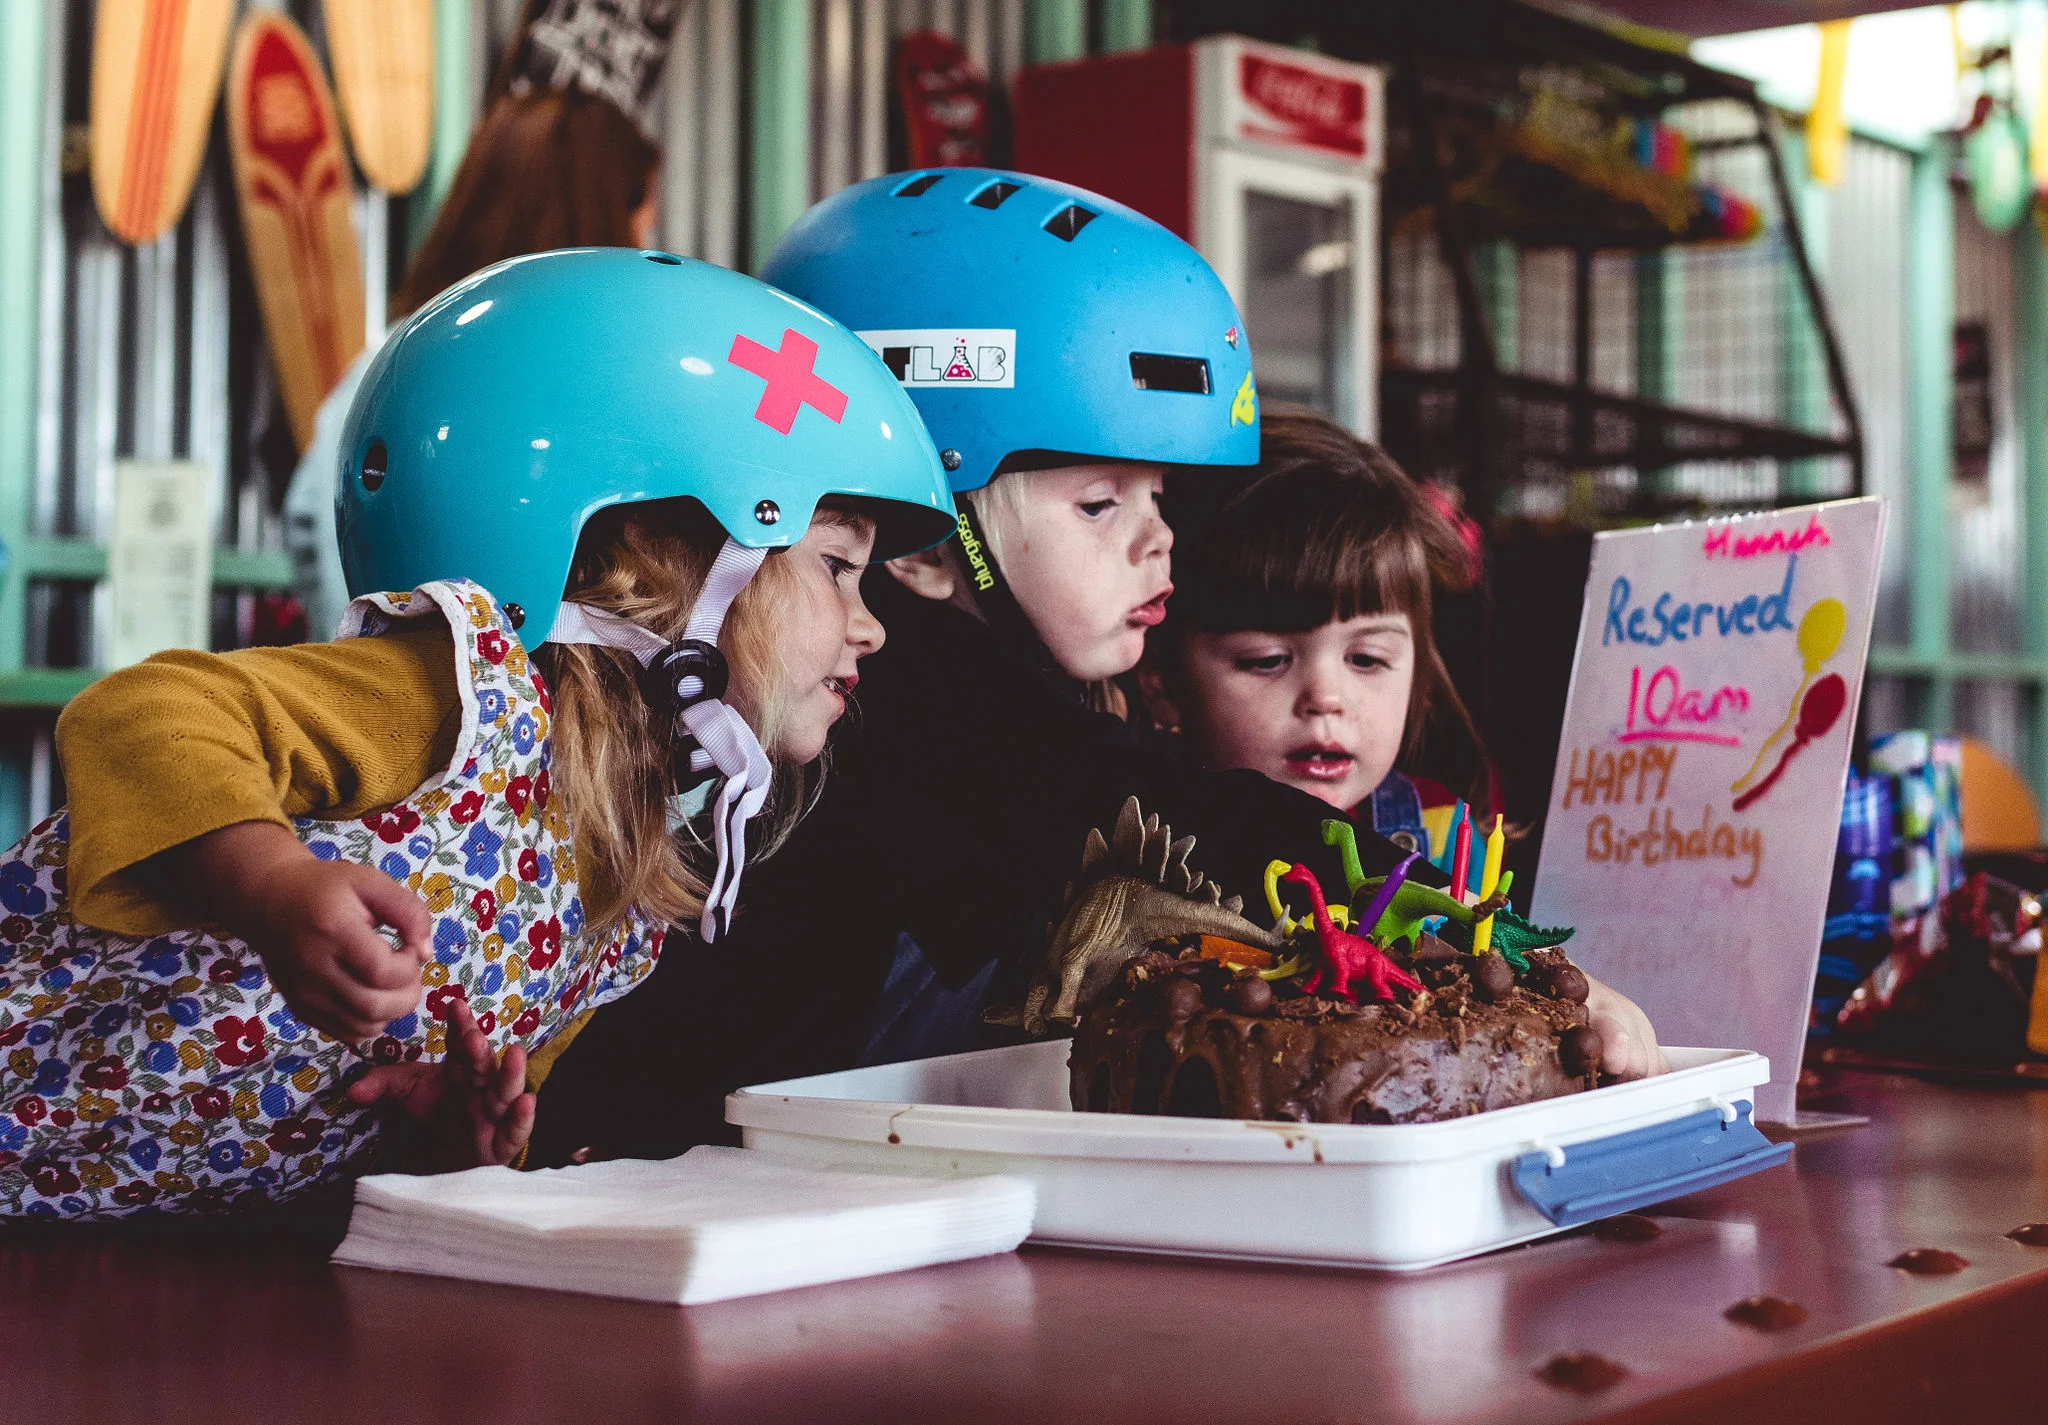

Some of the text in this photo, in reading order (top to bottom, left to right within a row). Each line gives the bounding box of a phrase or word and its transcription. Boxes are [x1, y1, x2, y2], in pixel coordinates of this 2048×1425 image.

[872, 346, 1007, 382] TLAB
[958, 513, 995, 591] bluegrass
[1625, 664, 1750, 730] 10am
[1562, 746, 1678, 810] HAPPY
[1586, 804, 1761, 888] Birthday
